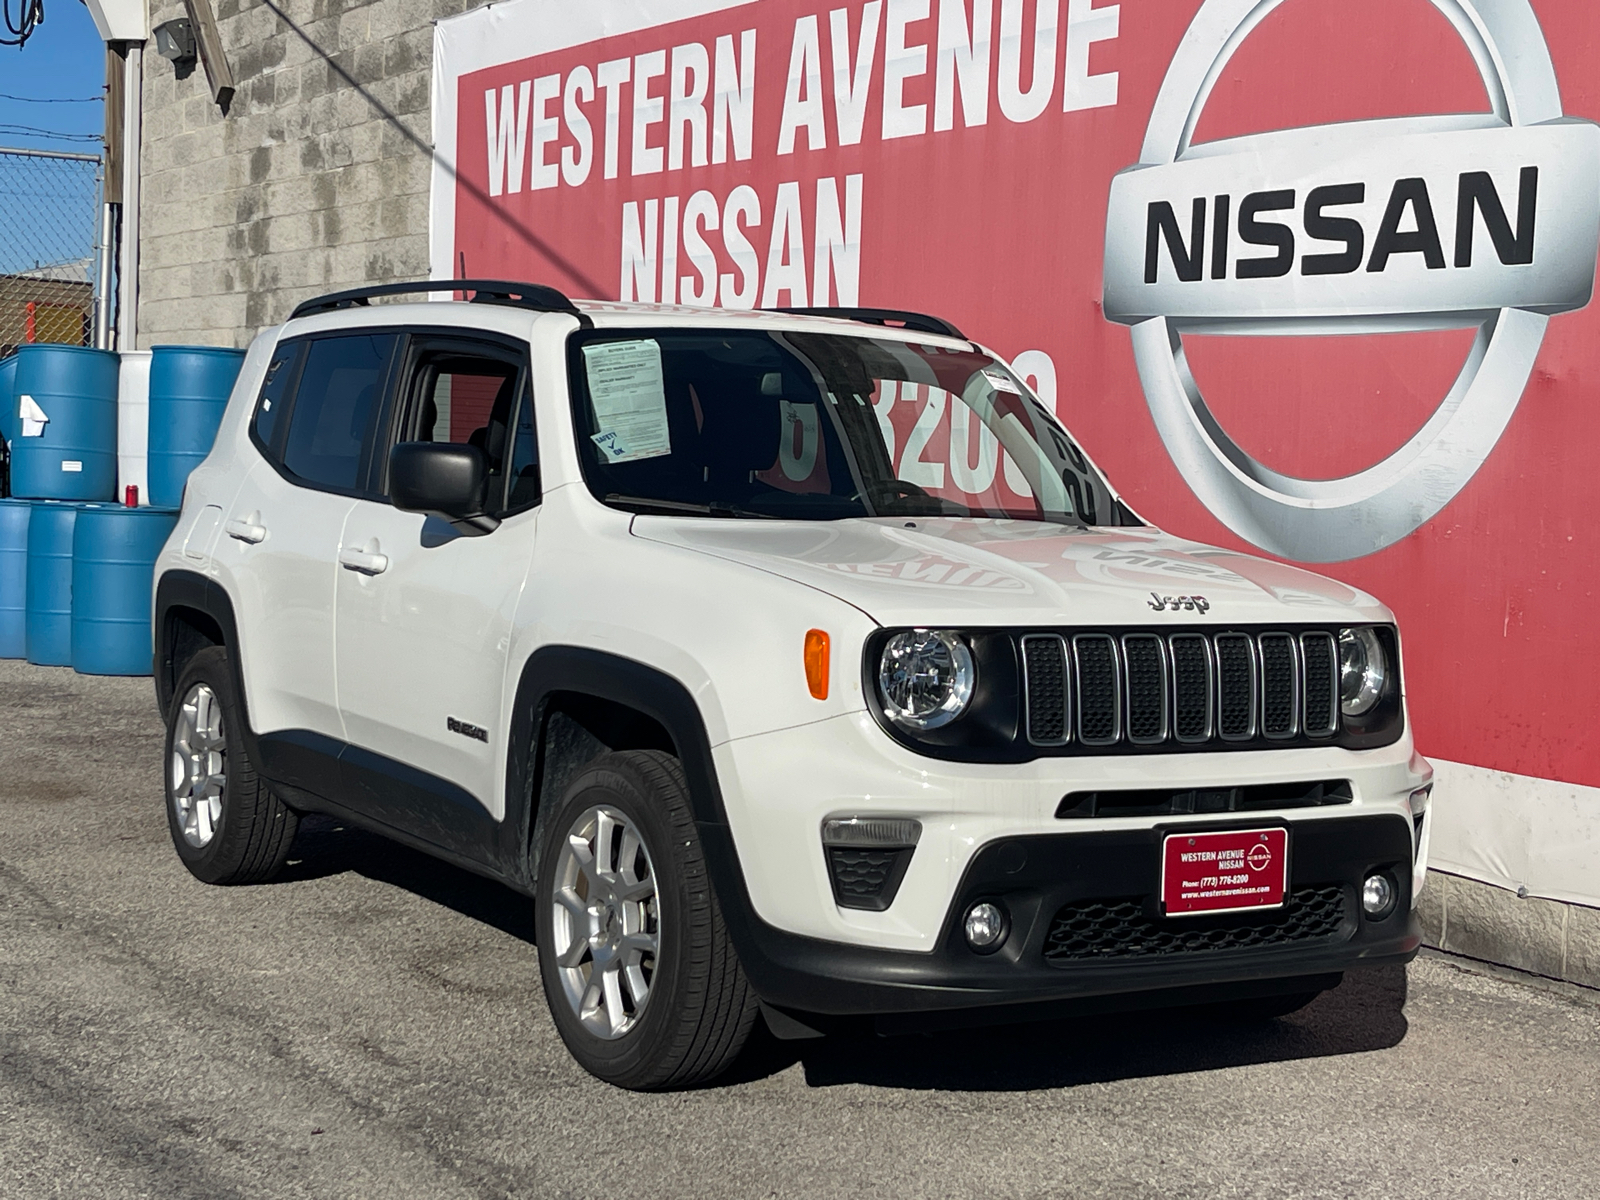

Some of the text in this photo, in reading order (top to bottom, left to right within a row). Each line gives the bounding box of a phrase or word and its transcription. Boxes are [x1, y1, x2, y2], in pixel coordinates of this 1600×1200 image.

[485, 0, 1120, 197] WESTERN AVENUE
[1144, 166, 1539, 284] NISSAN
[621, 173, 864, 309] NISSAN
[613, 447, 625, 456] OK
[1147, 592, 1210, 615] Jeep
[1181, 849, 1244, 862] WESTERN AVENUE
[1218, 860, 1244, 870] NISSAN
[1200, 876, 1218, 888] (773)
[1219, 874, 1248, 885] 776-8200
[1181, 886, 1270, 899] www.westernavenissan.com
